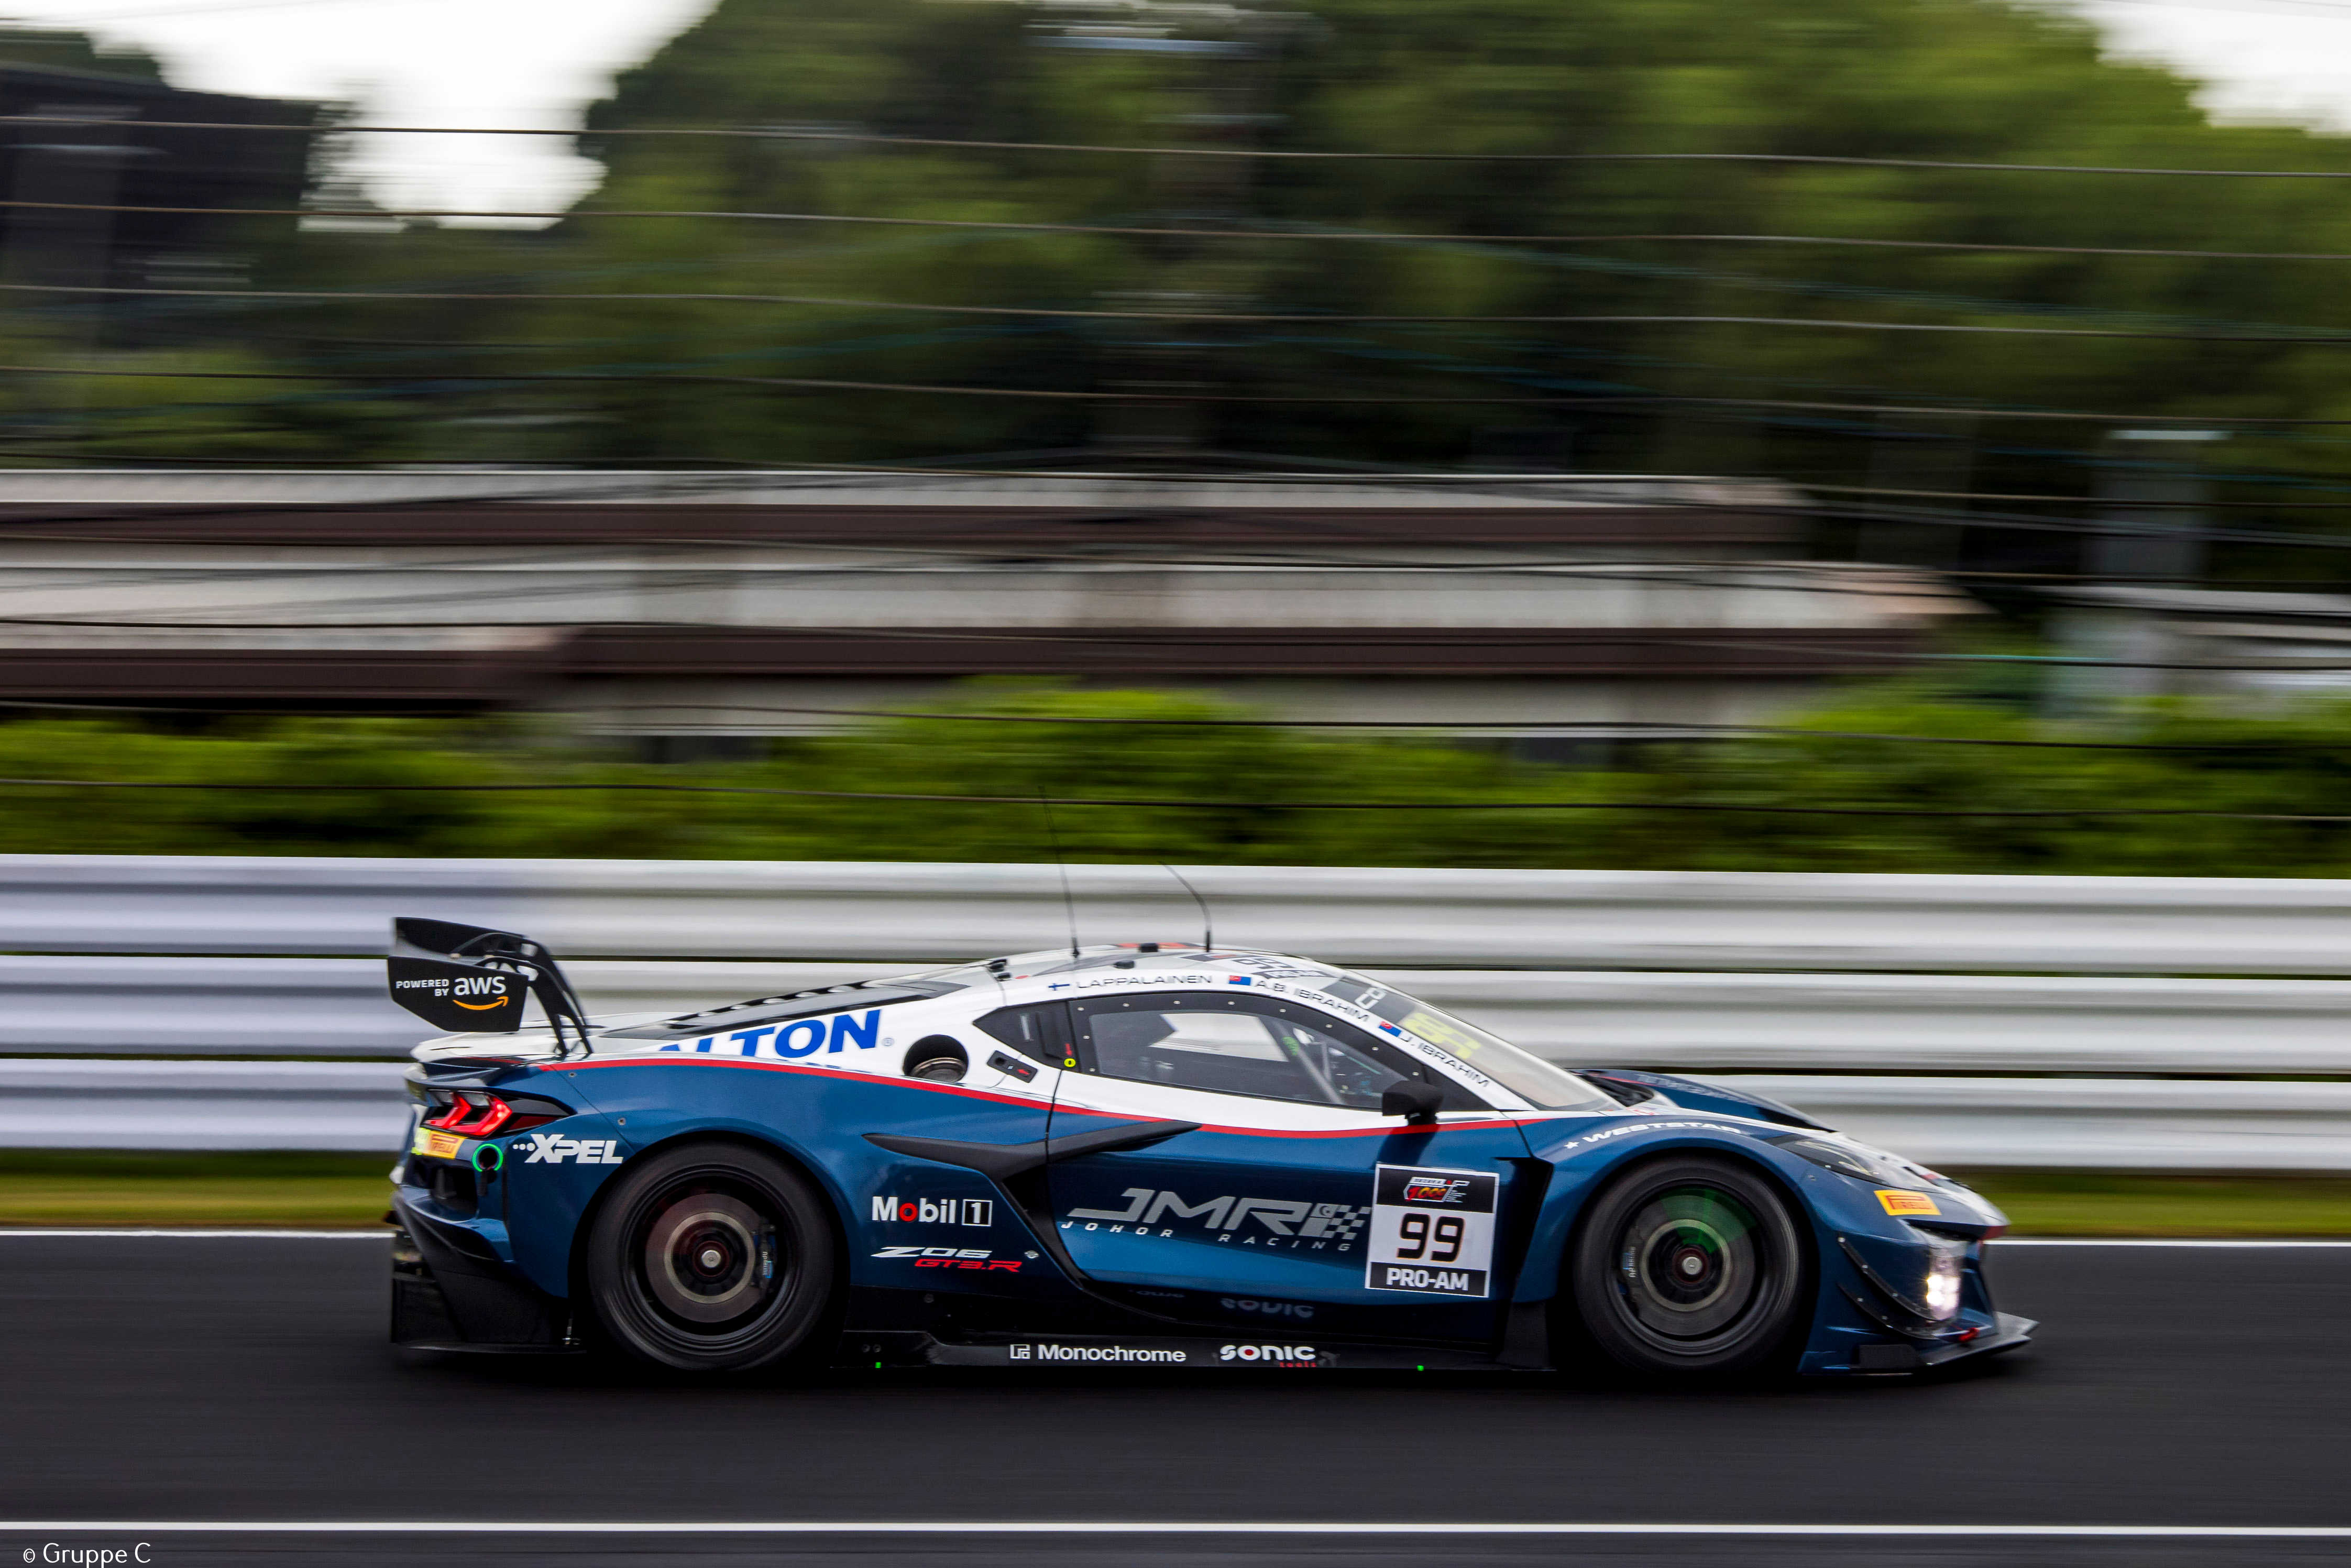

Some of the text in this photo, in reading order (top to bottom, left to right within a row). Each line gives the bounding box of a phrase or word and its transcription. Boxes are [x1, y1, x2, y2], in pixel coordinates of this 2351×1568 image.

[395, 979, 449, 989] POWERED
[434, 988, 449, 996] BY
[454, 976, 507, 996] aws
[1076, 975, 1212, 989] LAPPALAINEN
[1293, 988, 1370, 1022] IBRAHIM
[1418, 1043, 1490, 1088] IBRAHIM
[1582, 1122, 1743, 1143] WESTSTAR
[524, 1134, 624, 1164] XPEL
[872, 1196, 957, 1223] Mobil
[1067, 1188, 1312, 1237] JMR
[1061, 1221, 1351, 1252] JOHOR RACING
[1396, 1212, 1465, 1263] 99
[871, 1246, 993, 1258] Z06
[914, 1258, 1022, 1273] GT3.R
[1386, 1268, 1469, 1291] PRO-AM
[1038, 1344, 1187, 1363] Monochrome
